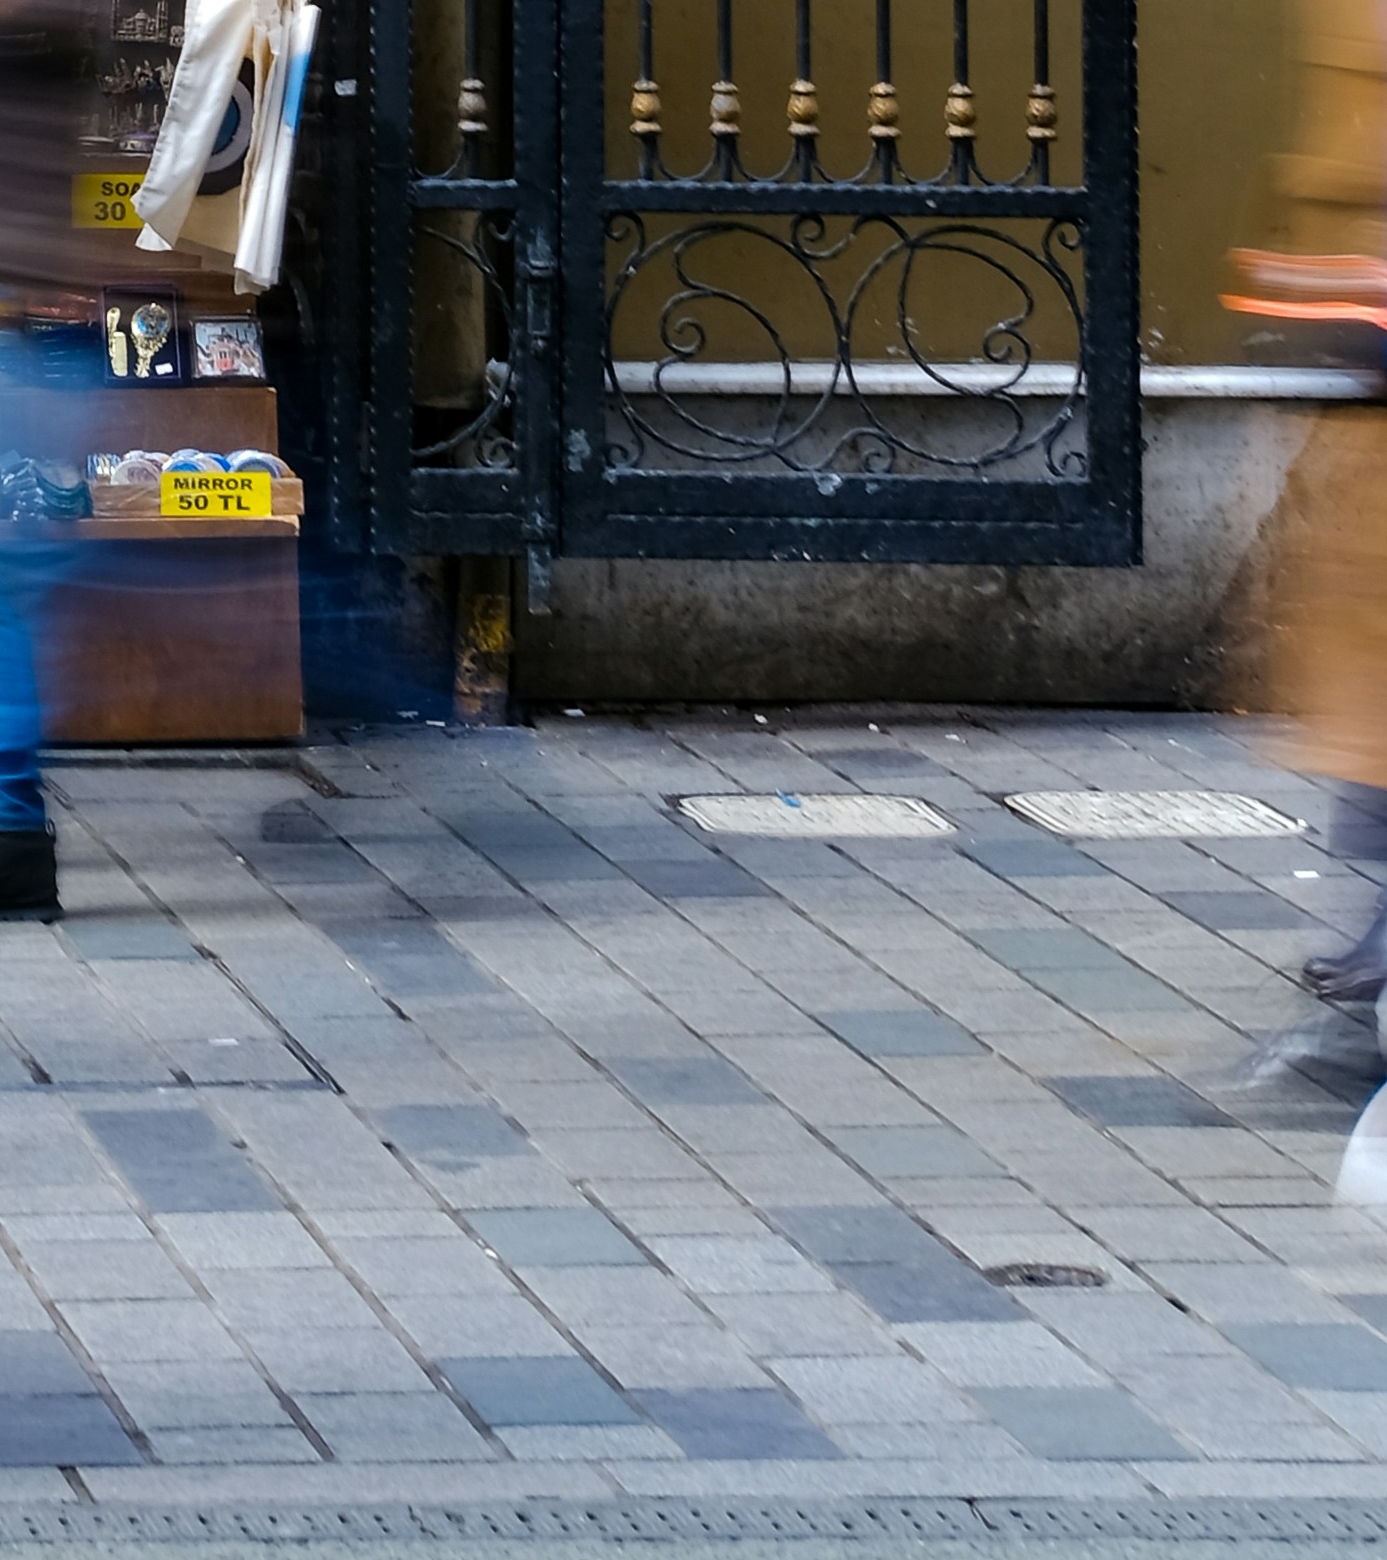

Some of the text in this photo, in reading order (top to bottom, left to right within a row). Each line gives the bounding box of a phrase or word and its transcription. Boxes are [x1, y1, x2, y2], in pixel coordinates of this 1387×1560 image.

[101, 181, 141, 197] SOA
[94, 202, 125, 222] 30
[172, 477, 253, 491] MIRROR
[178, 493, 251, 511] 50 TL
